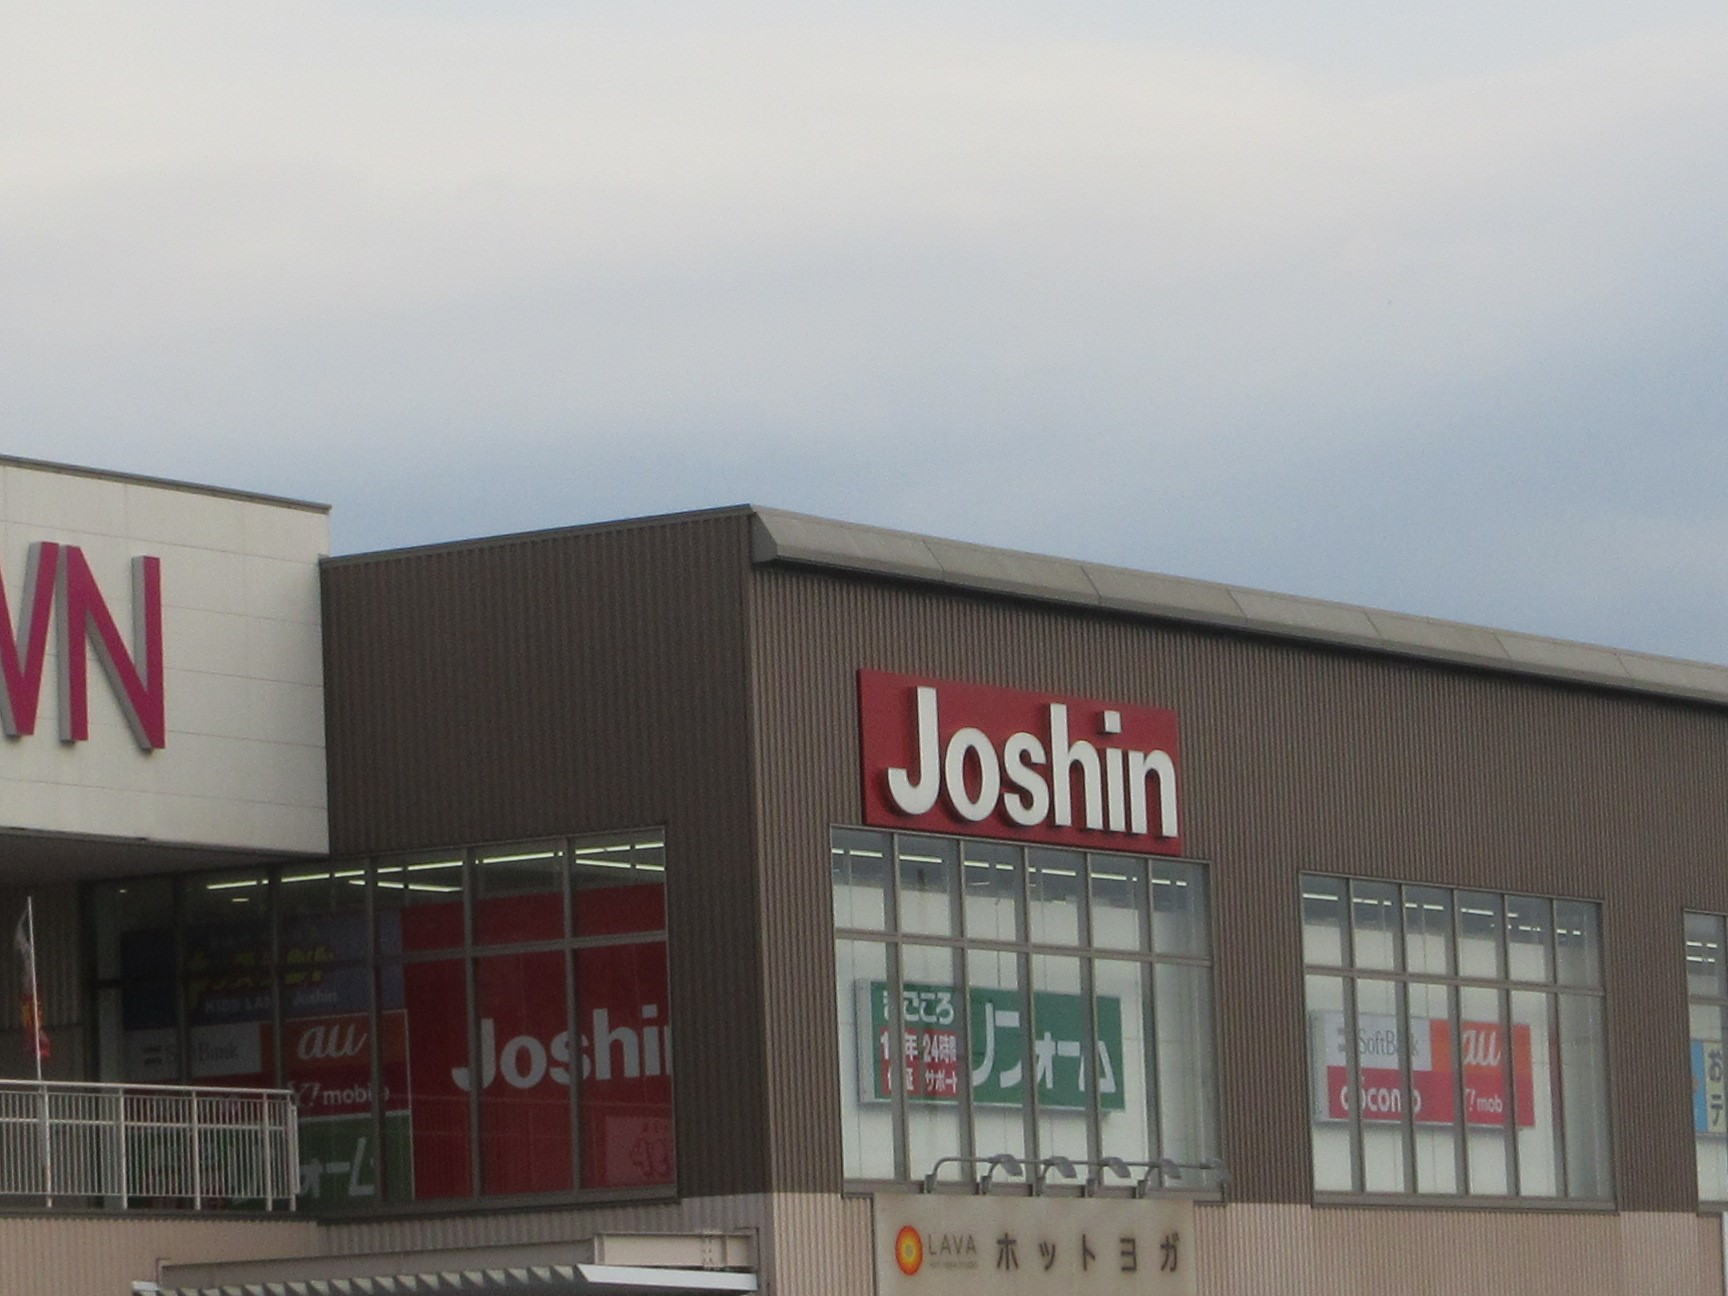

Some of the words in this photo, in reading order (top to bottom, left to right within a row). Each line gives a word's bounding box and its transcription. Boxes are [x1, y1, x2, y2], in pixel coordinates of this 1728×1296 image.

[887, 685, 1179, 839] Joshin
[296, 1024, 368, 1060] au
[451, 1003, 673, 1092] Joshi
[880, 1031, 918, 1061] 1年
[928, 1234, 977, 1256] LAVA
[996, 1232, 1181, 1273] ホットヨガ
